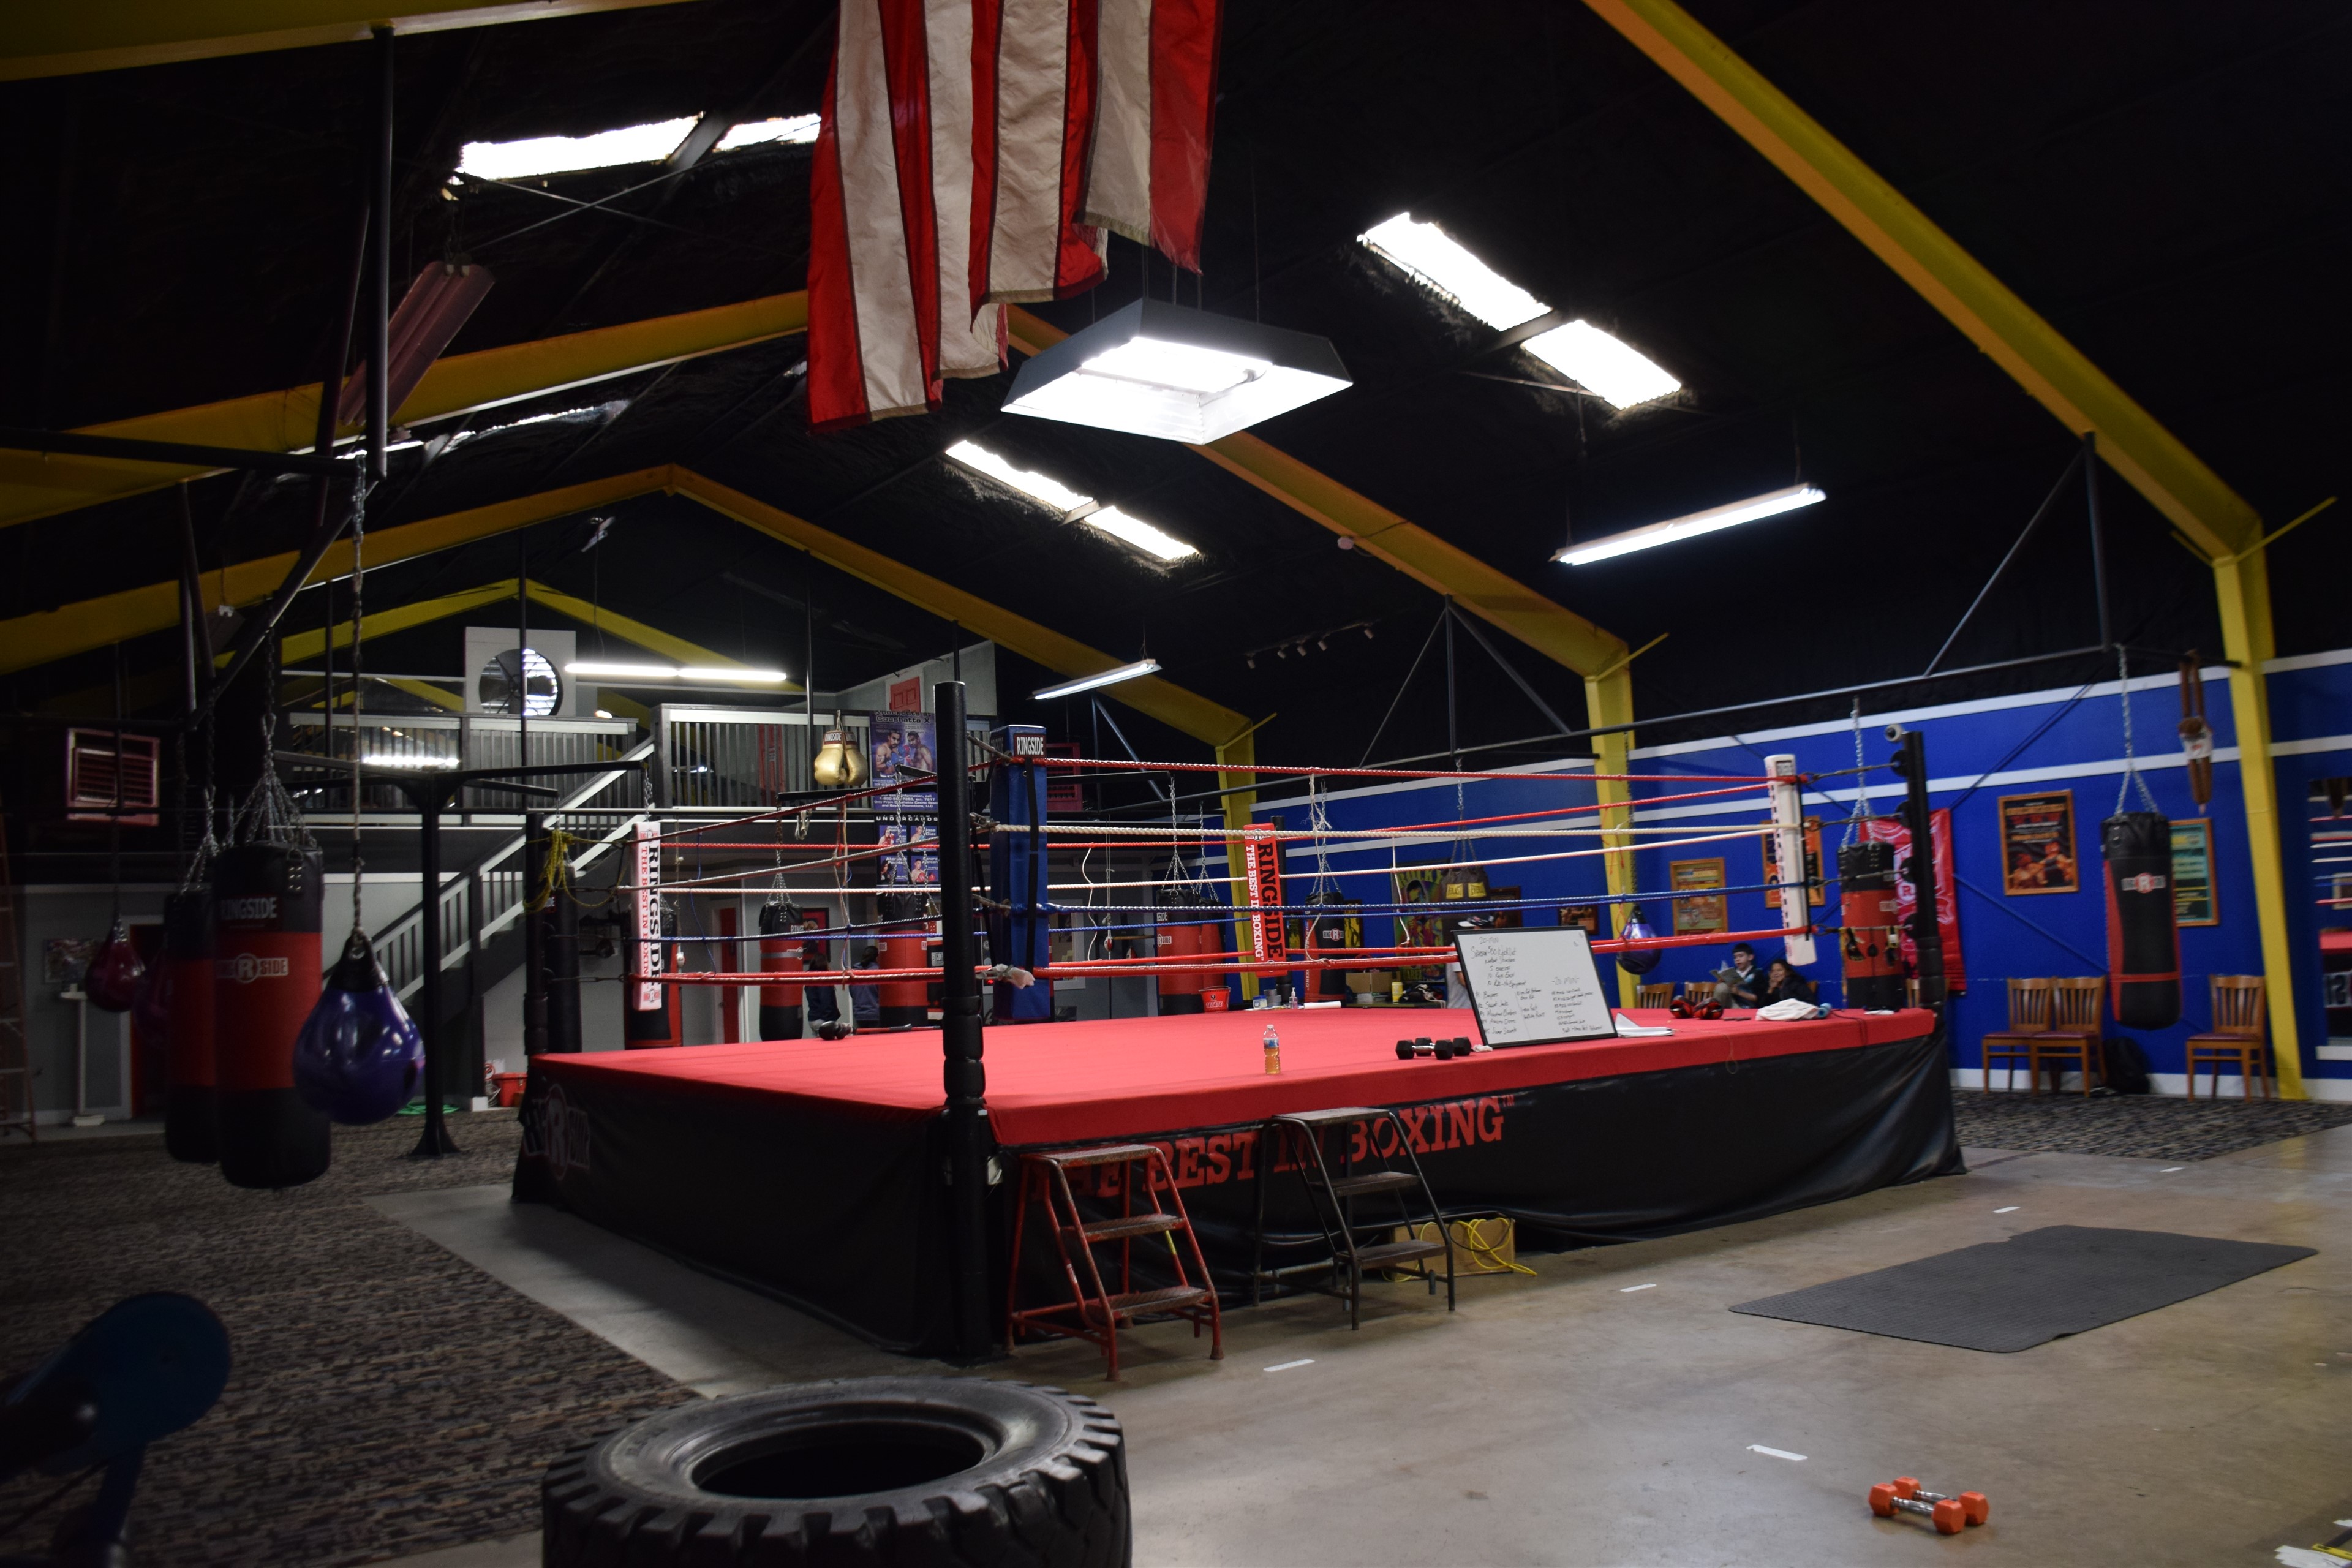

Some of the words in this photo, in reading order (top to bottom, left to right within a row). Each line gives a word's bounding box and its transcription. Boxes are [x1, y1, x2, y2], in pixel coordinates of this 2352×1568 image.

[1017, 737, 1044, 755] RINGSIDE
[1246, 845, 1256, 869] THE
[1248, 869, 1259, 898] BEST
[1253, 914, 1264, 958] BOXING
[260, 960, 286, 976] SIDE
[1142, 1129, 1259, 1192] BEST
[1340, 1096, 1505, 1164] BOXING
